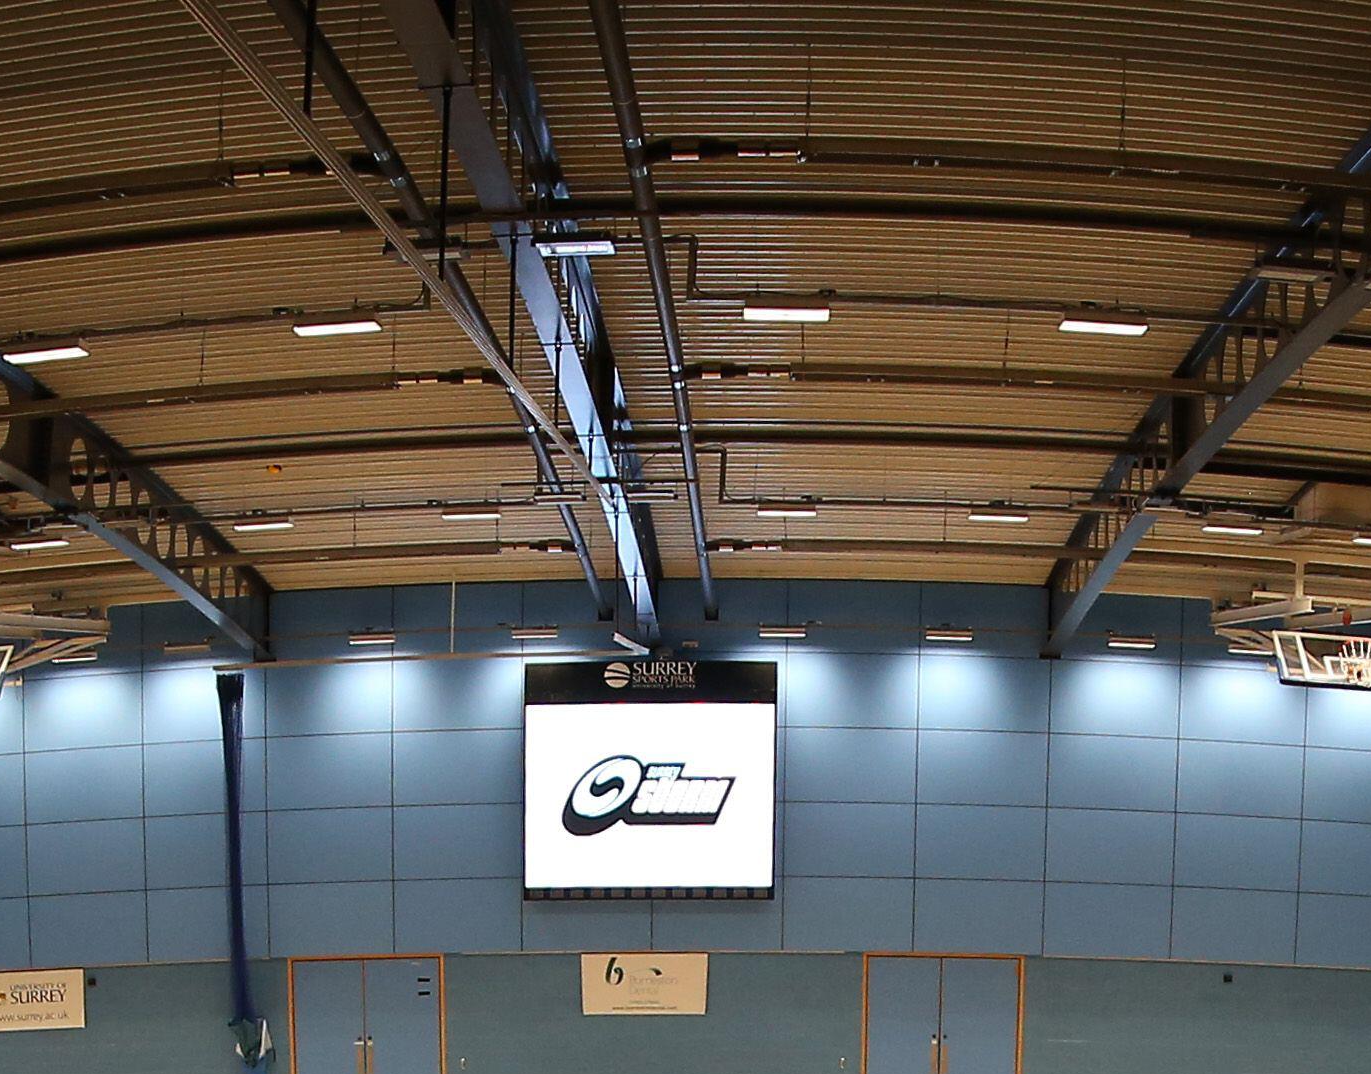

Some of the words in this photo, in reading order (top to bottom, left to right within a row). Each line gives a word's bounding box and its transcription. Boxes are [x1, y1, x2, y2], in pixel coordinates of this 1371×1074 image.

[633, 662, 697, 676] SURREY
[632, 675, 669, 683] SPORTS
[10, 989, 67, 1004] SURREY
